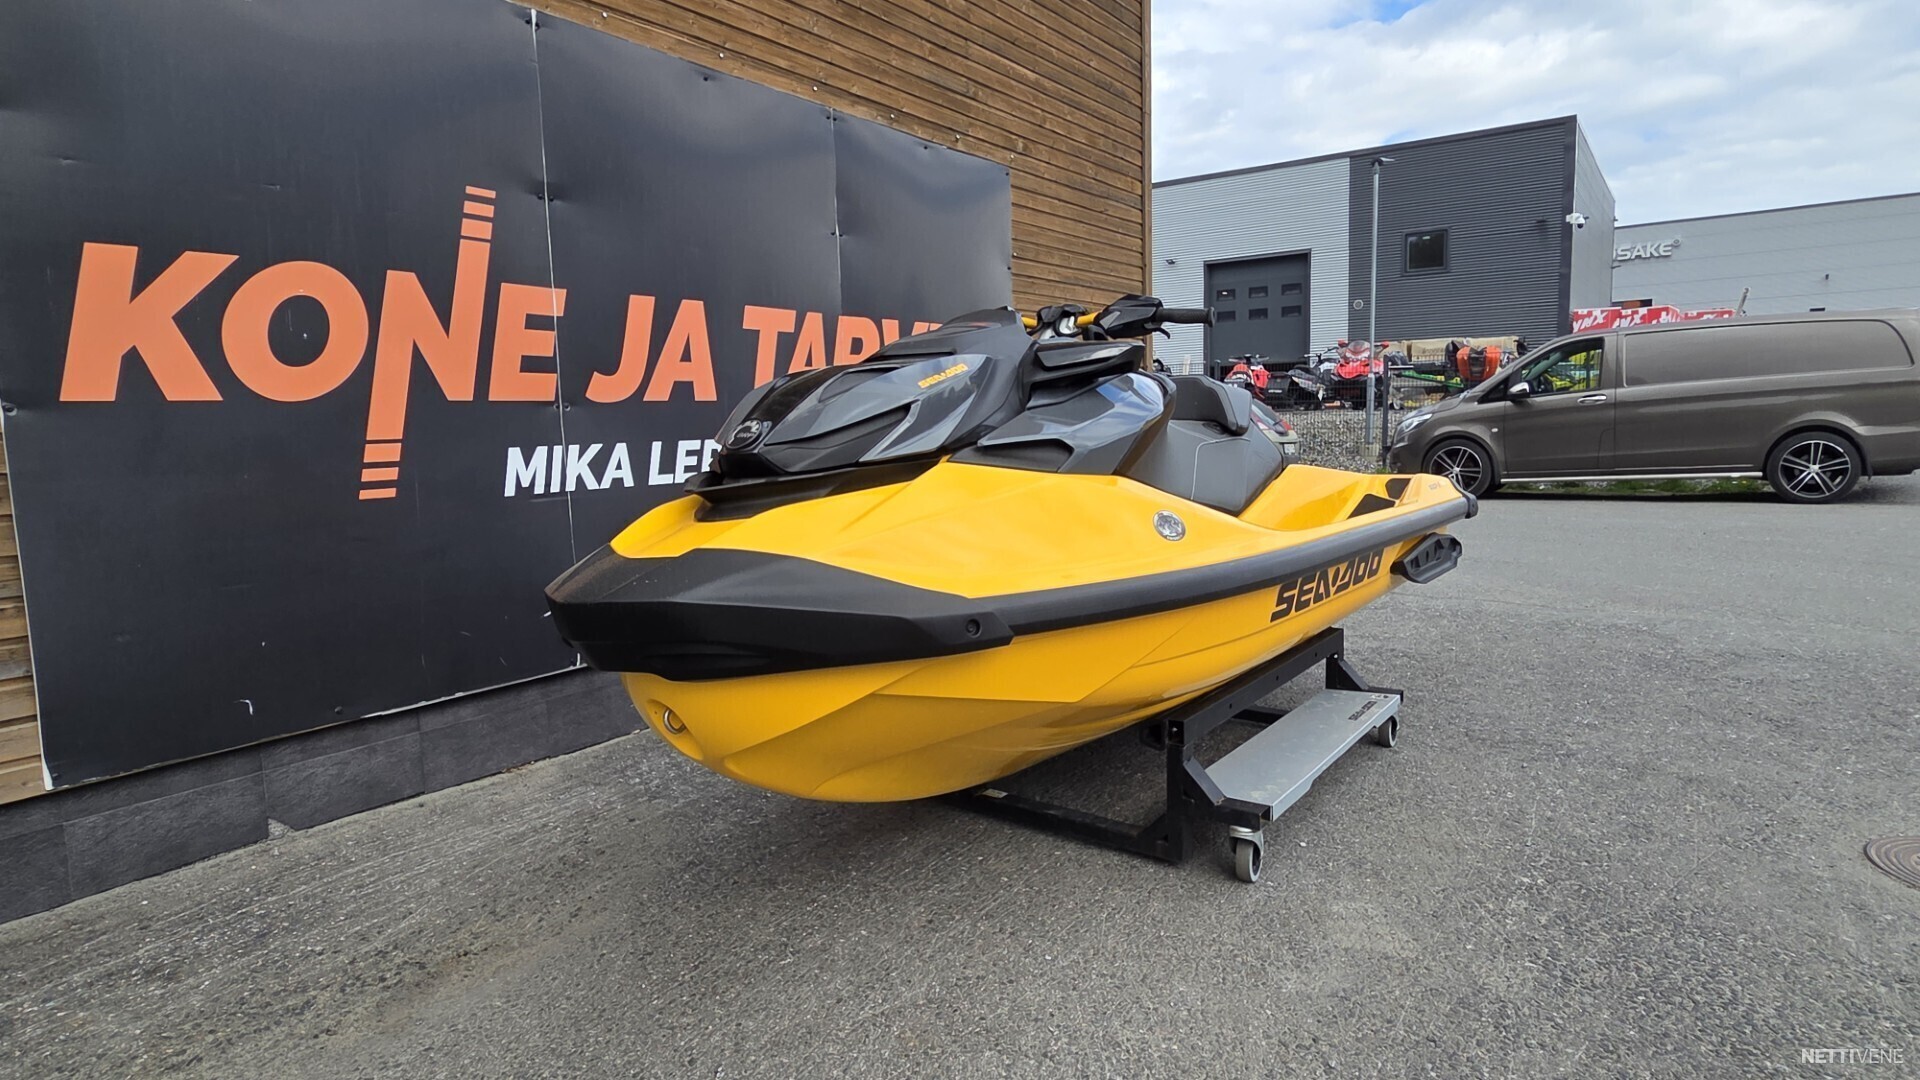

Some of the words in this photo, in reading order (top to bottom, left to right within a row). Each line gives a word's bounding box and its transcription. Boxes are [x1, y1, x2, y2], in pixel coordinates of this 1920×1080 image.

[1613, 241, 1673, 260] SAKE
[60, 185, 567, 500] KONE
[585, 294, 718, 403] JA
[504, 442, 635, 497] MIKA
